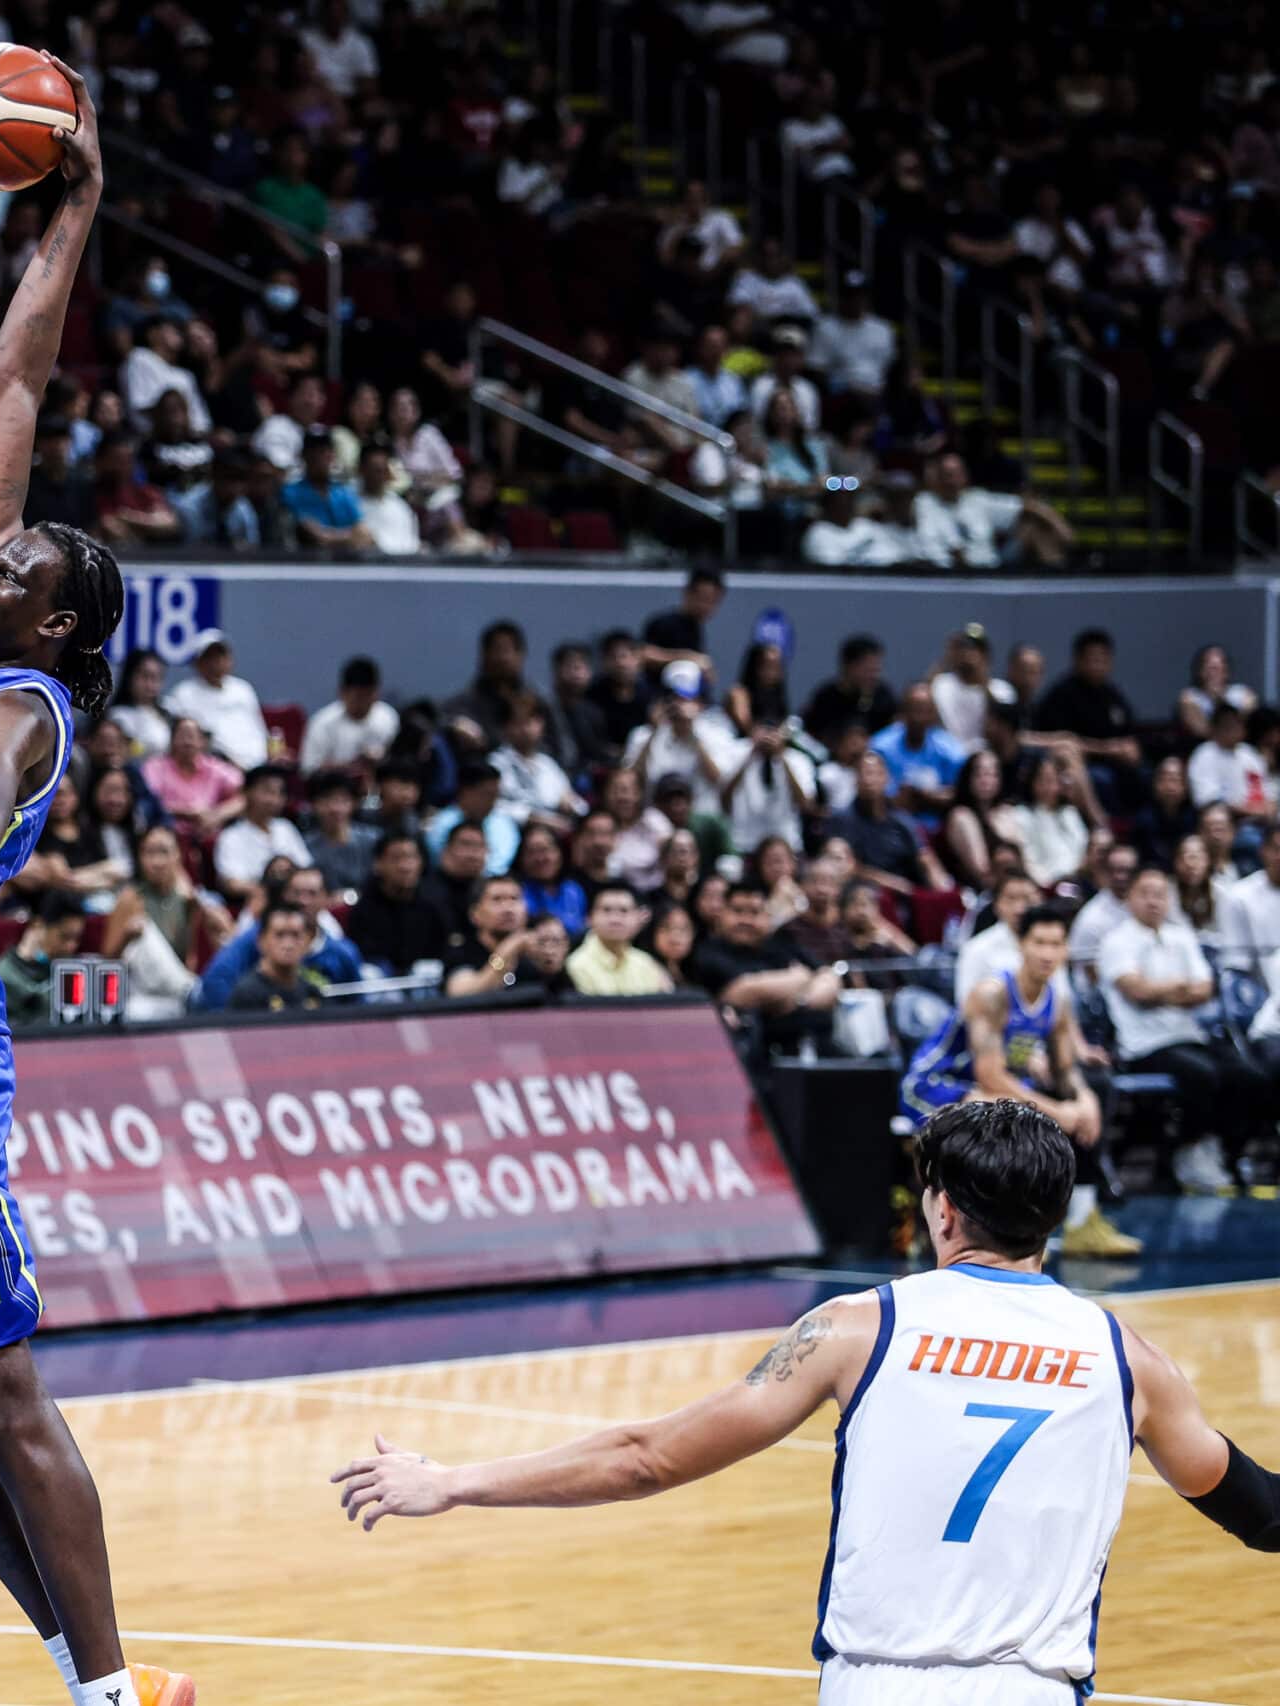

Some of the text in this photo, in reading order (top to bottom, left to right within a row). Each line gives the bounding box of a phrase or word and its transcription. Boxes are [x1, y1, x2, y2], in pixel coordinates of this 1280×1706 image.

[6, 1071, 676, 1176] PINO SPORTS, NEWS,
[22, 1138, 757, 1262] ES, AND MICRODRAMA
[908, 1334, 1099, 1389] HODGE
[941, 1402, 1054, 1543] 7
